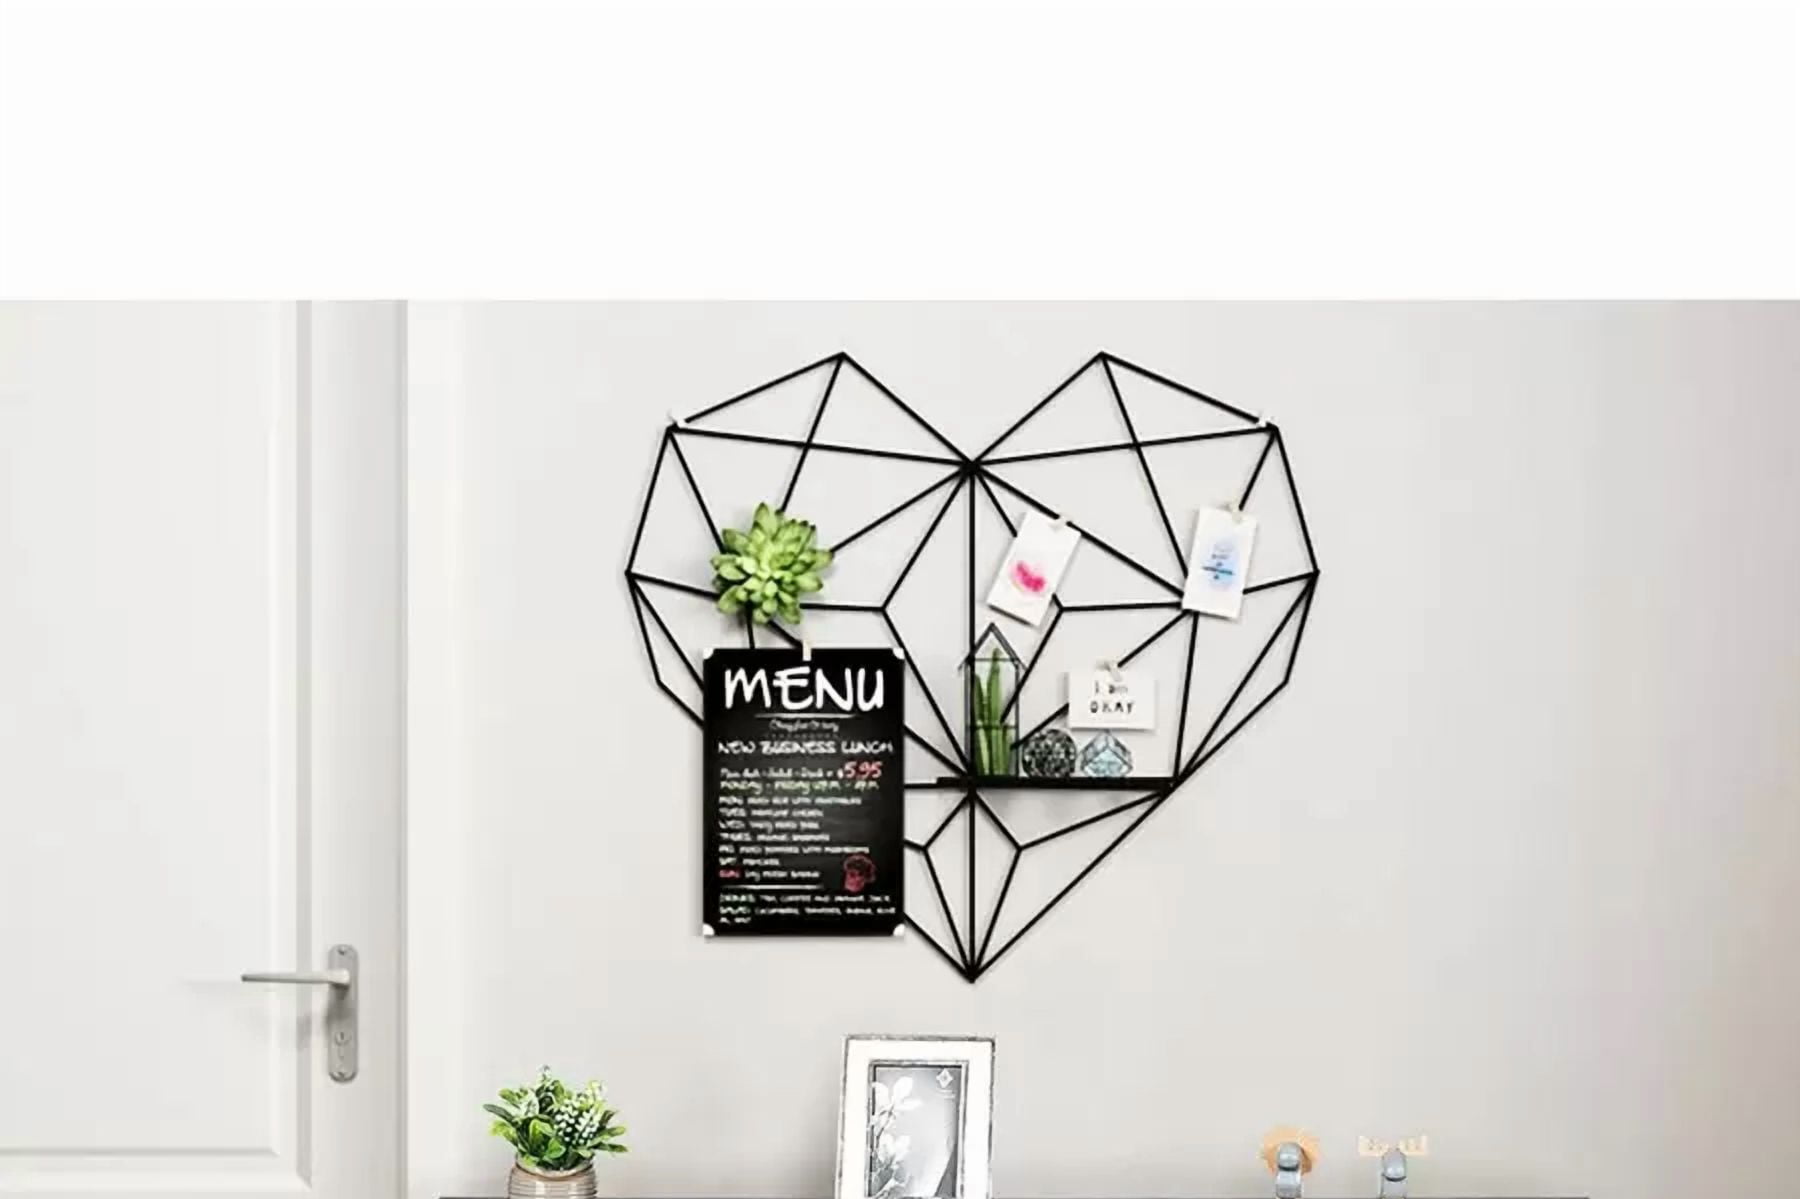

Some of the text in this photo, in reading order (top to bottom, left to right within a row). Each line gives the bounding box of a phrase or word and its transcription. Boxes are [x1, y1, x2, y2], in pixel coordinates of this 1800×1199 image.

[724, 665, 885, 712] MENU
[1089, 701, 1136, 714] OKAY
[718, 739, 894, 755] NEW BUSINESS LUNCH
